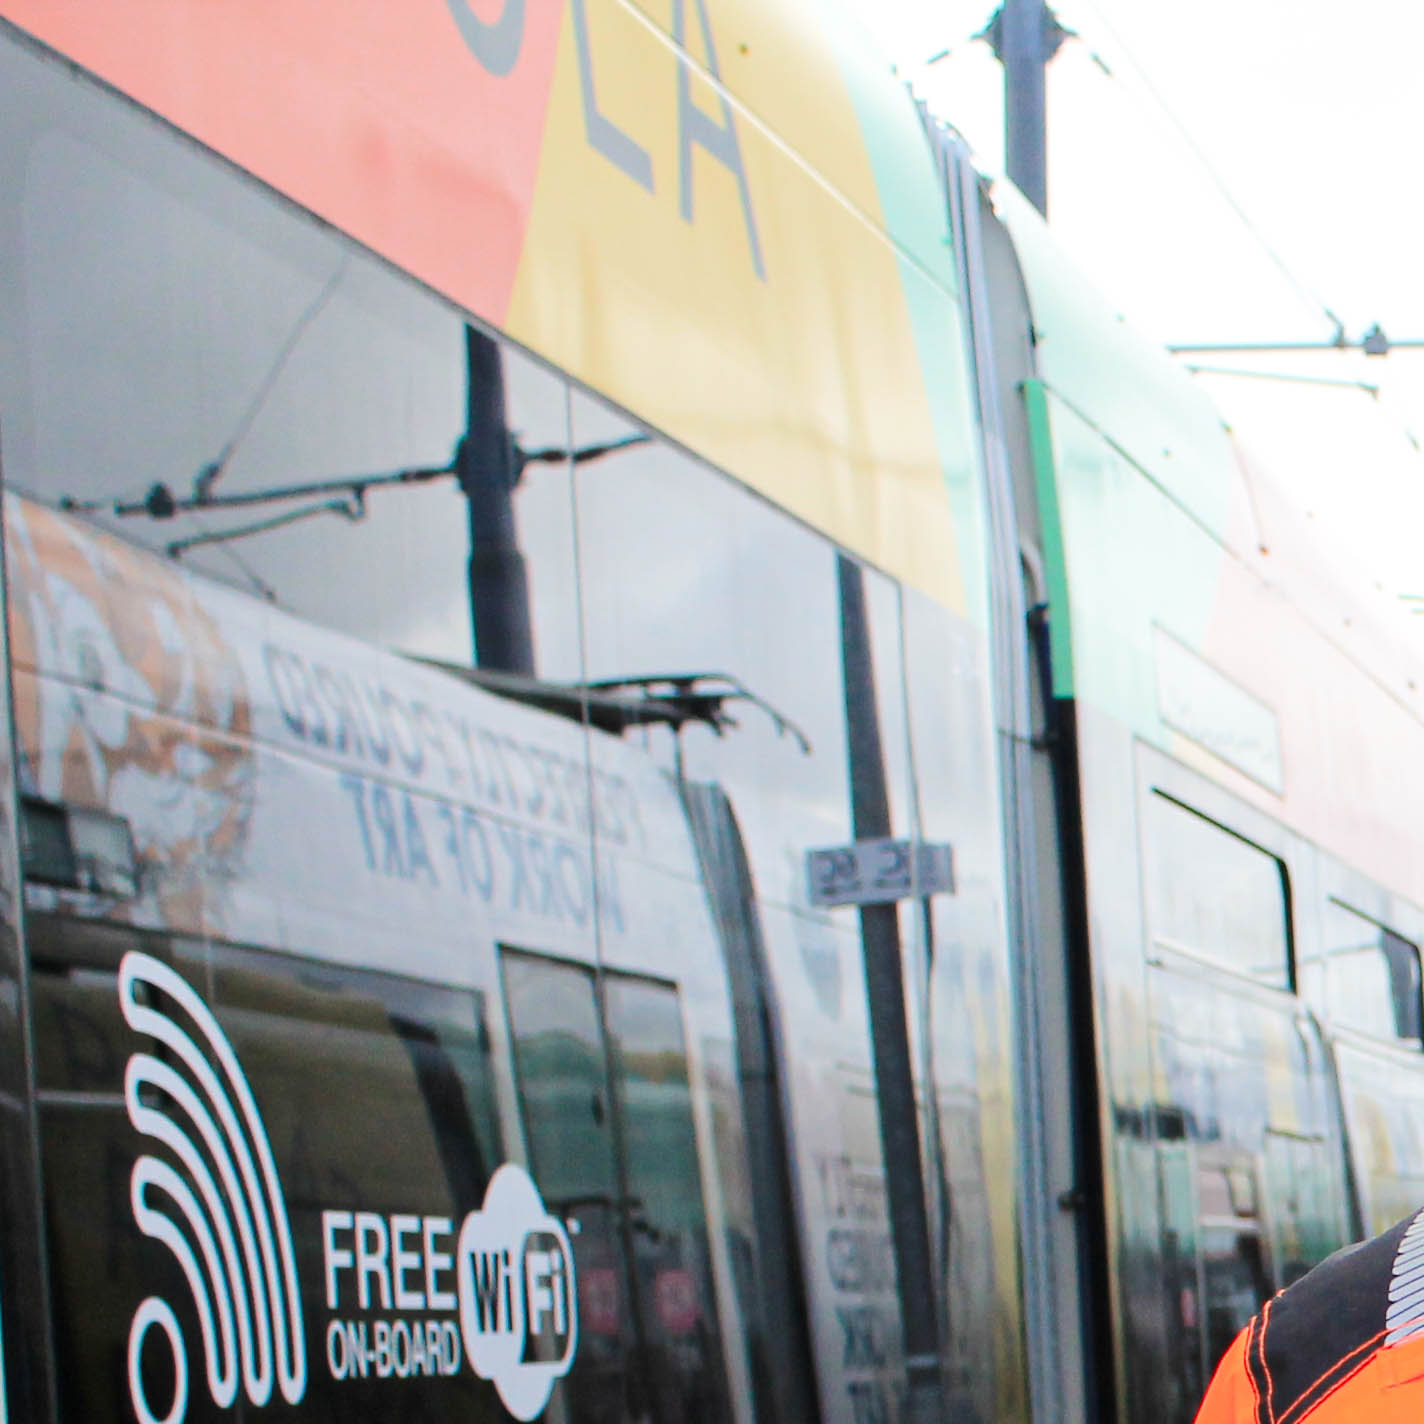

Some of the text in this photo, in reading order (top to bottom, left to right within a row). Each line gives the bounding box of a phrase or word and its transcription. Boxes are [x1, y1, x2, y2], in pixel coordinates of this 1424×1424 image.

[321, 1210, 458, 1310] FREE
[467, 1248, 566, 1336] WiFi
[326, 1319, 462, 1381] ON-BOARD
